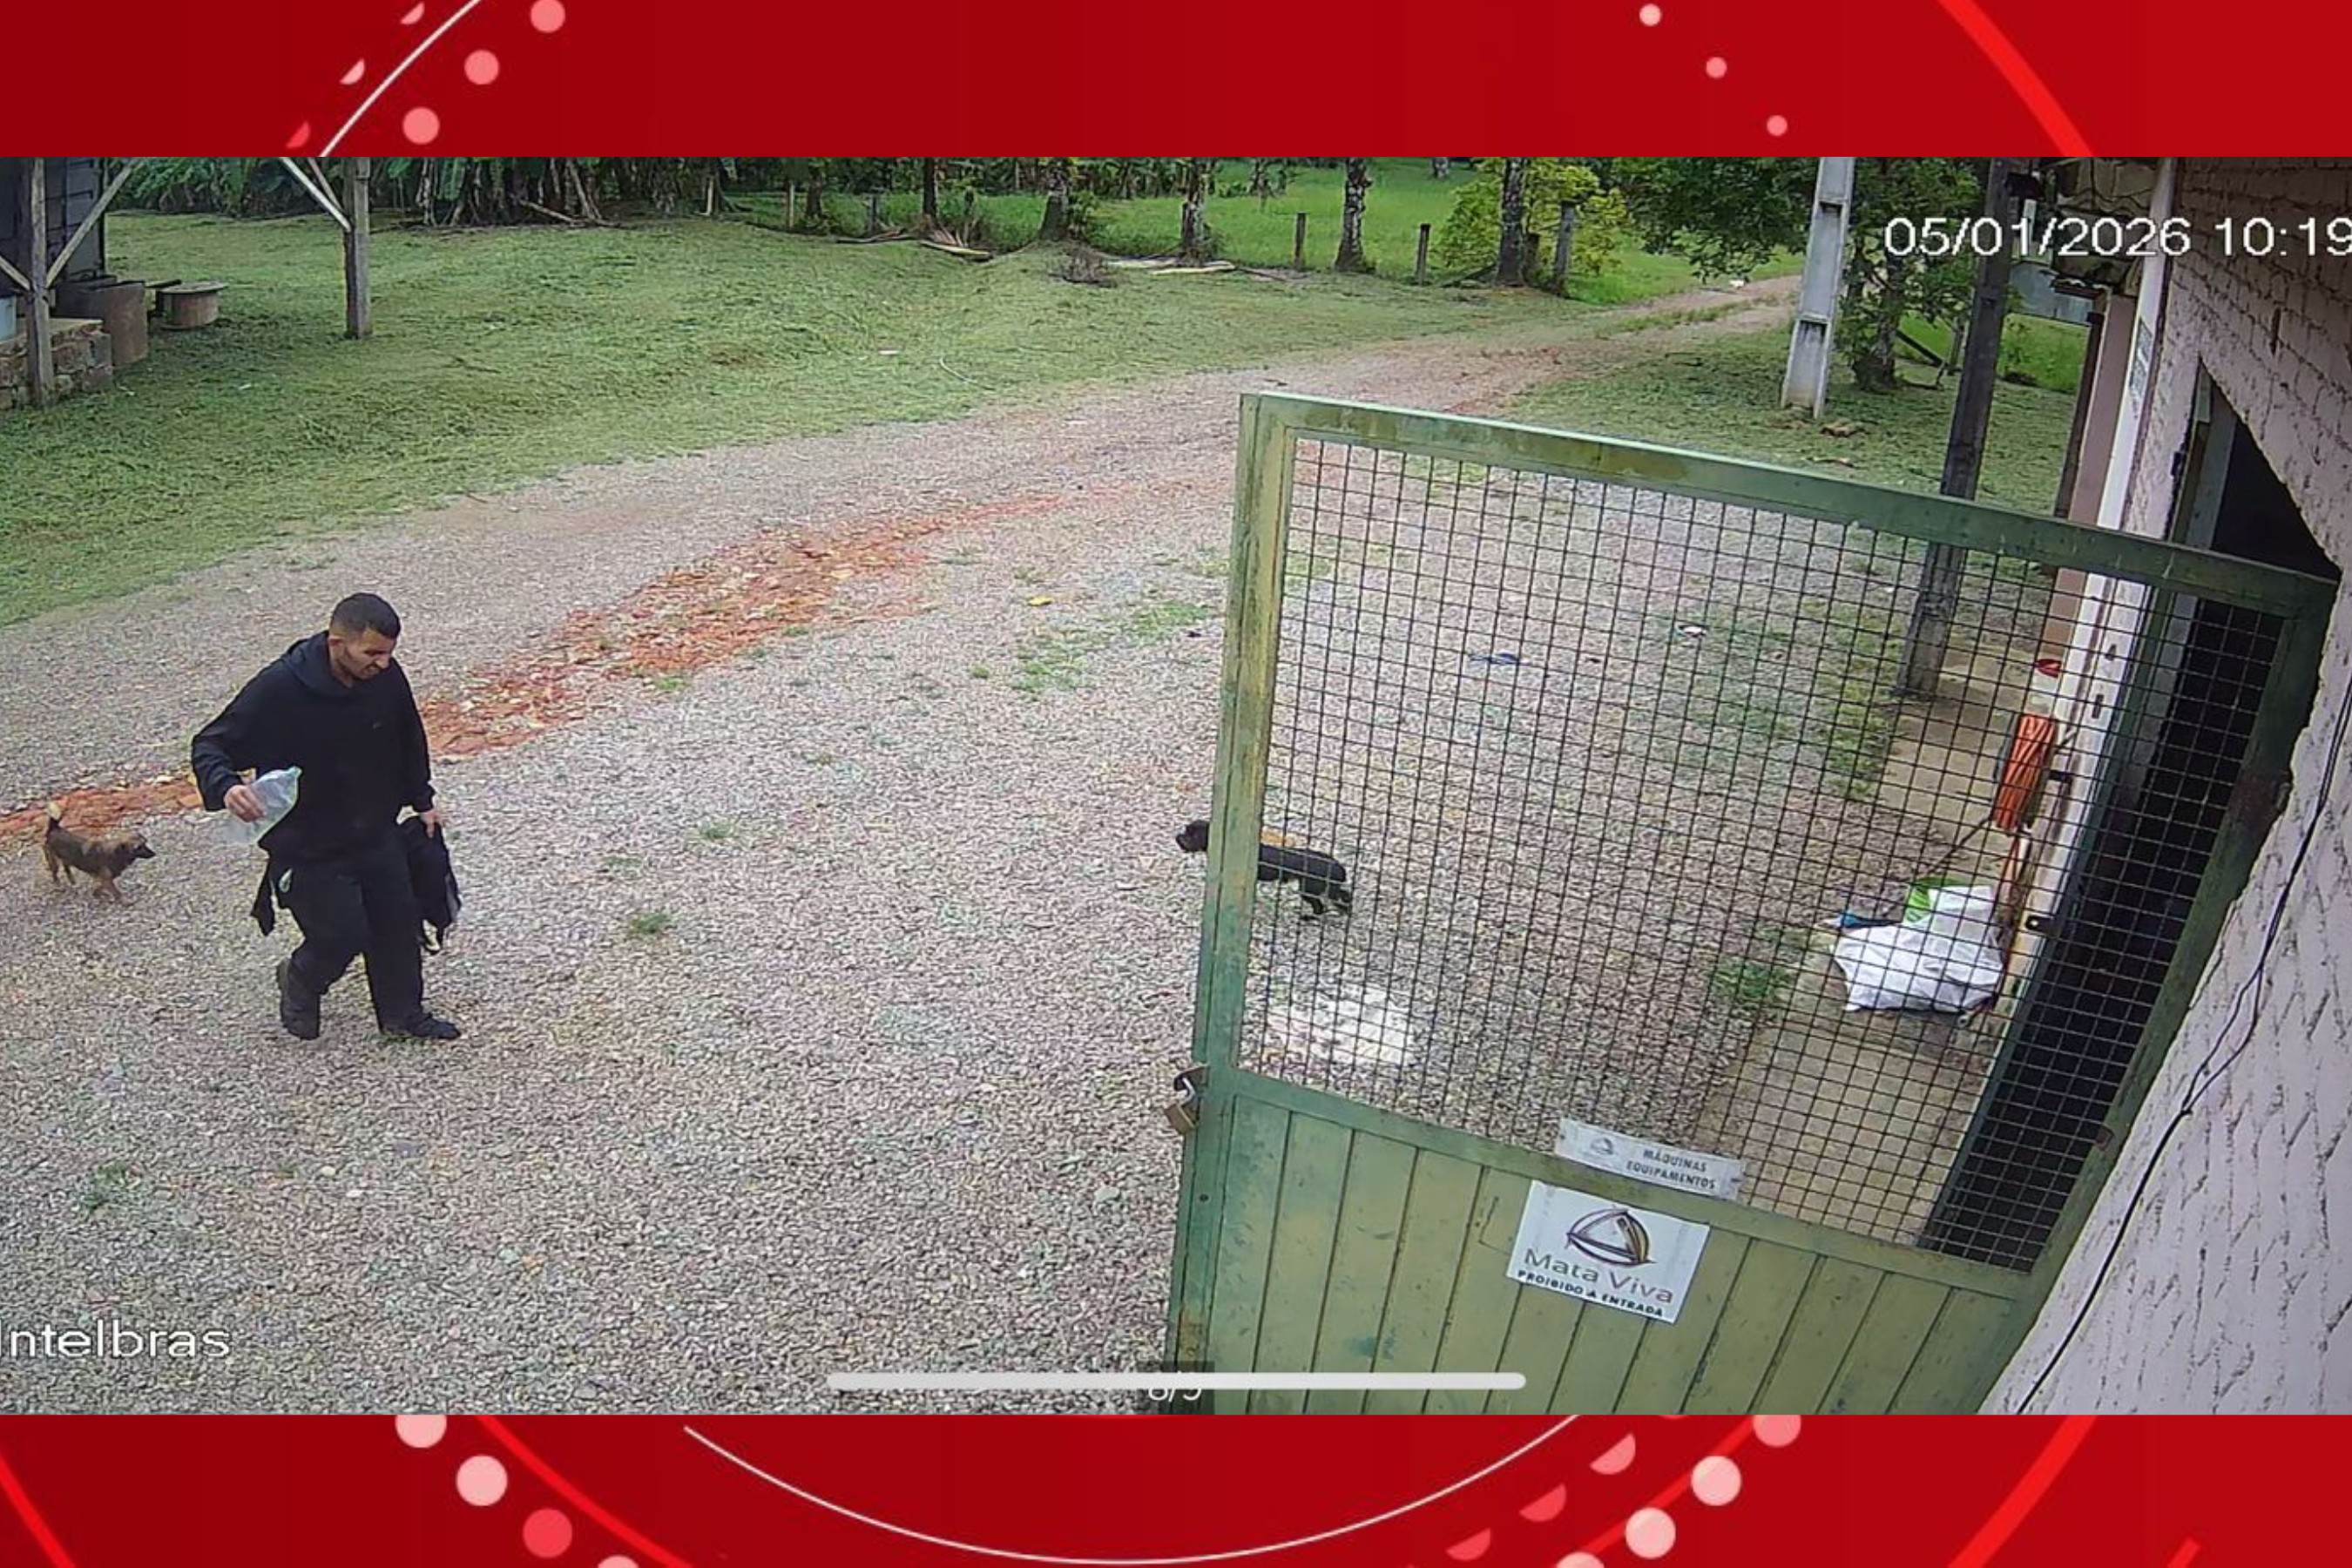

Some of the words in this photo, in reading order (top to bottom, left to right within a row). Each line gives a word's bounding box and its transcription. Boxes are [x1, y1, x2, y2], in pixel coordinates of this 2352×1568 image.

[1626, 1159, 1716, 1190] EQUIPAMENTOS
[1518, 1269, 1584, 1294] PROIBIDO
[1601, 1293, 1663, 1318] ENTRADA
[1524, 1248, 1599, 1283] Mata
[1609, 1270, 1673, 1303] Viva
